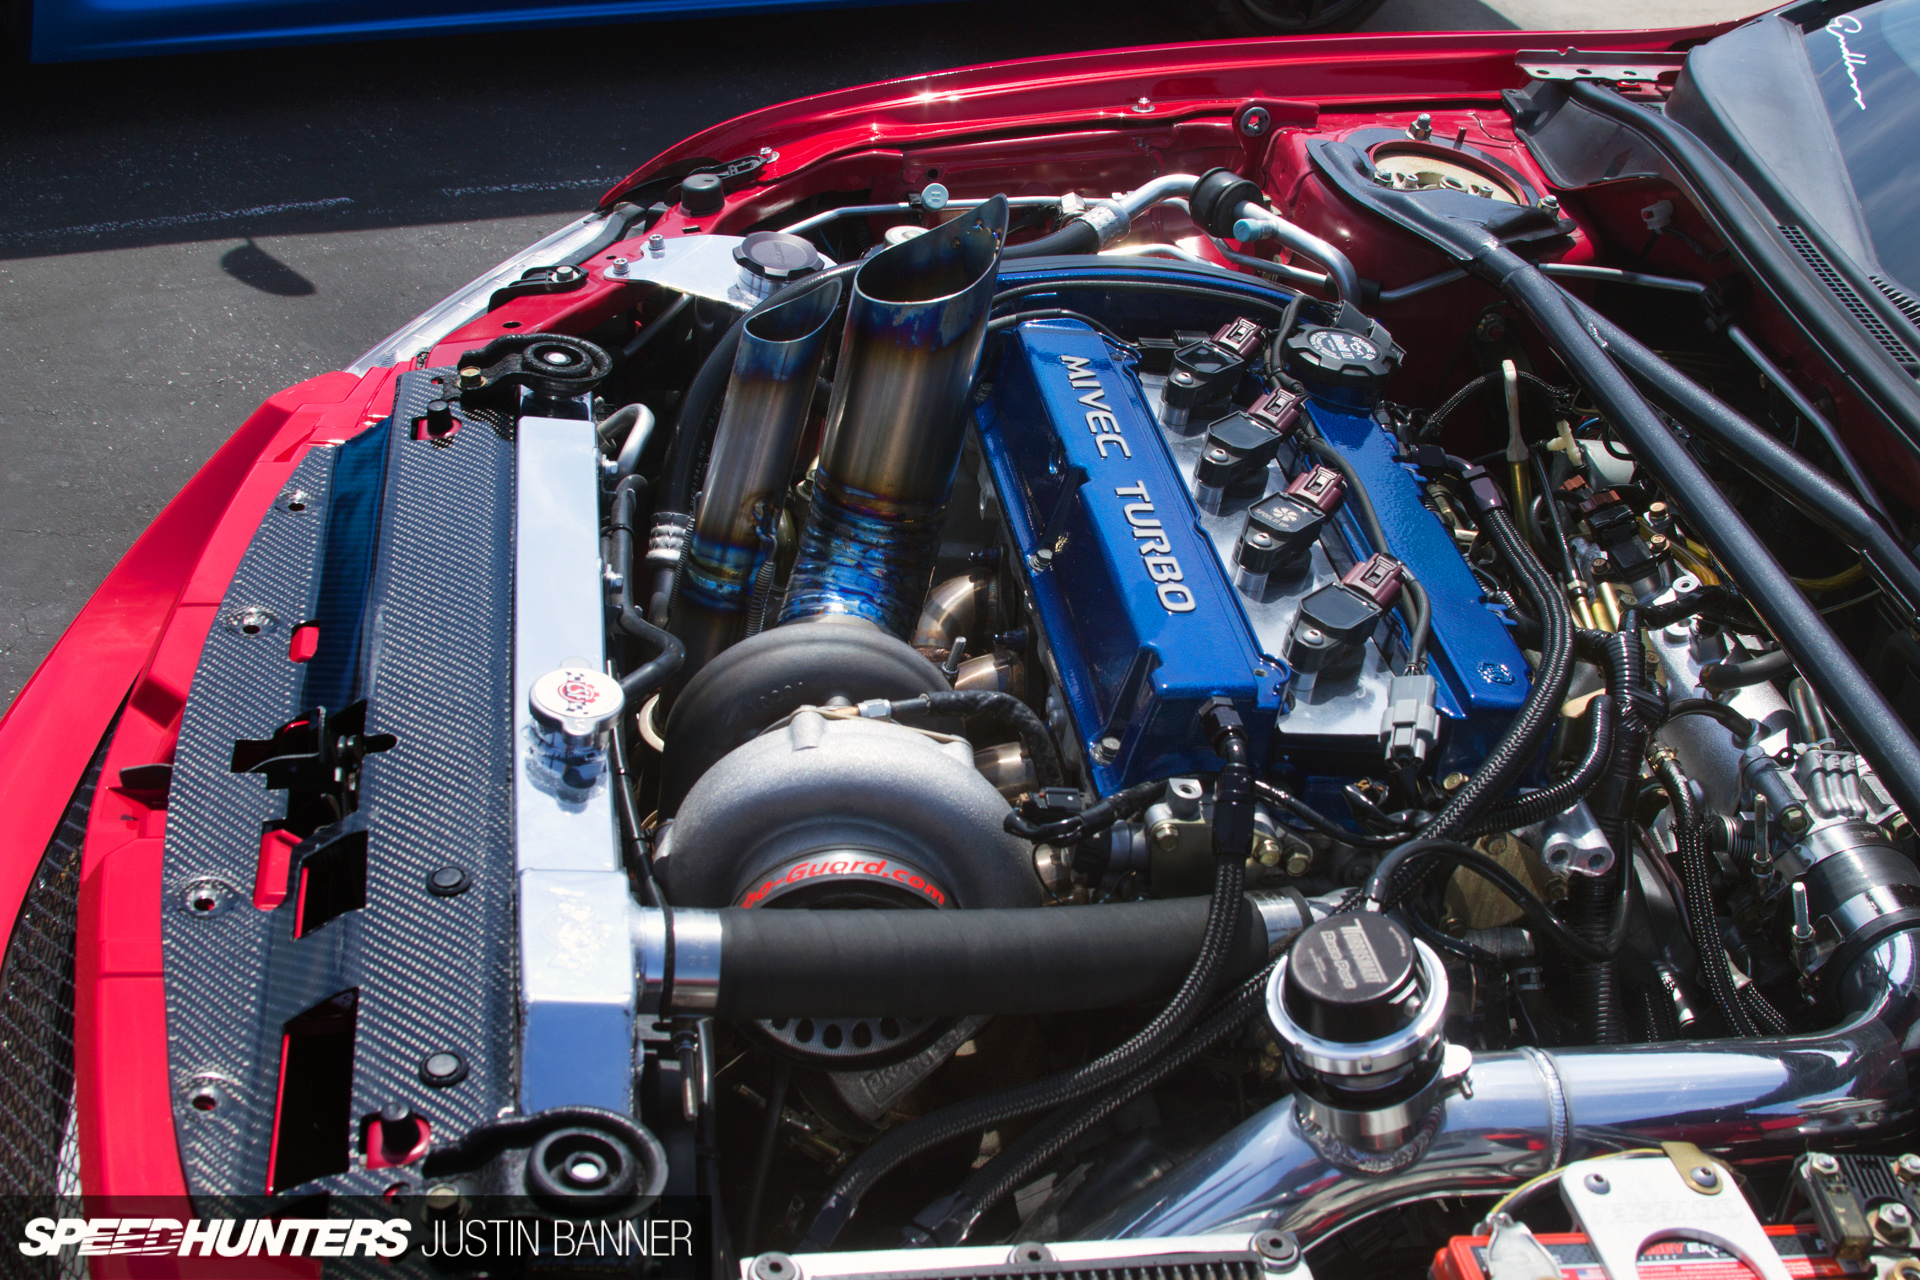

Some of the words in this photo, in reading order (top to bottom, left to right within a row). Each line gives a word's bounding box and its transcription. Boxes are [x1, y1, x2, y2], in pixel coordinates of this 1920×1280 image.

[1060, 355, 1132, 459] MIVEC
[1115, 480, 1196, 612] TURBO
[1320, 930, 1343, 961] Race
[1334, 959, 1357, 989] Port
